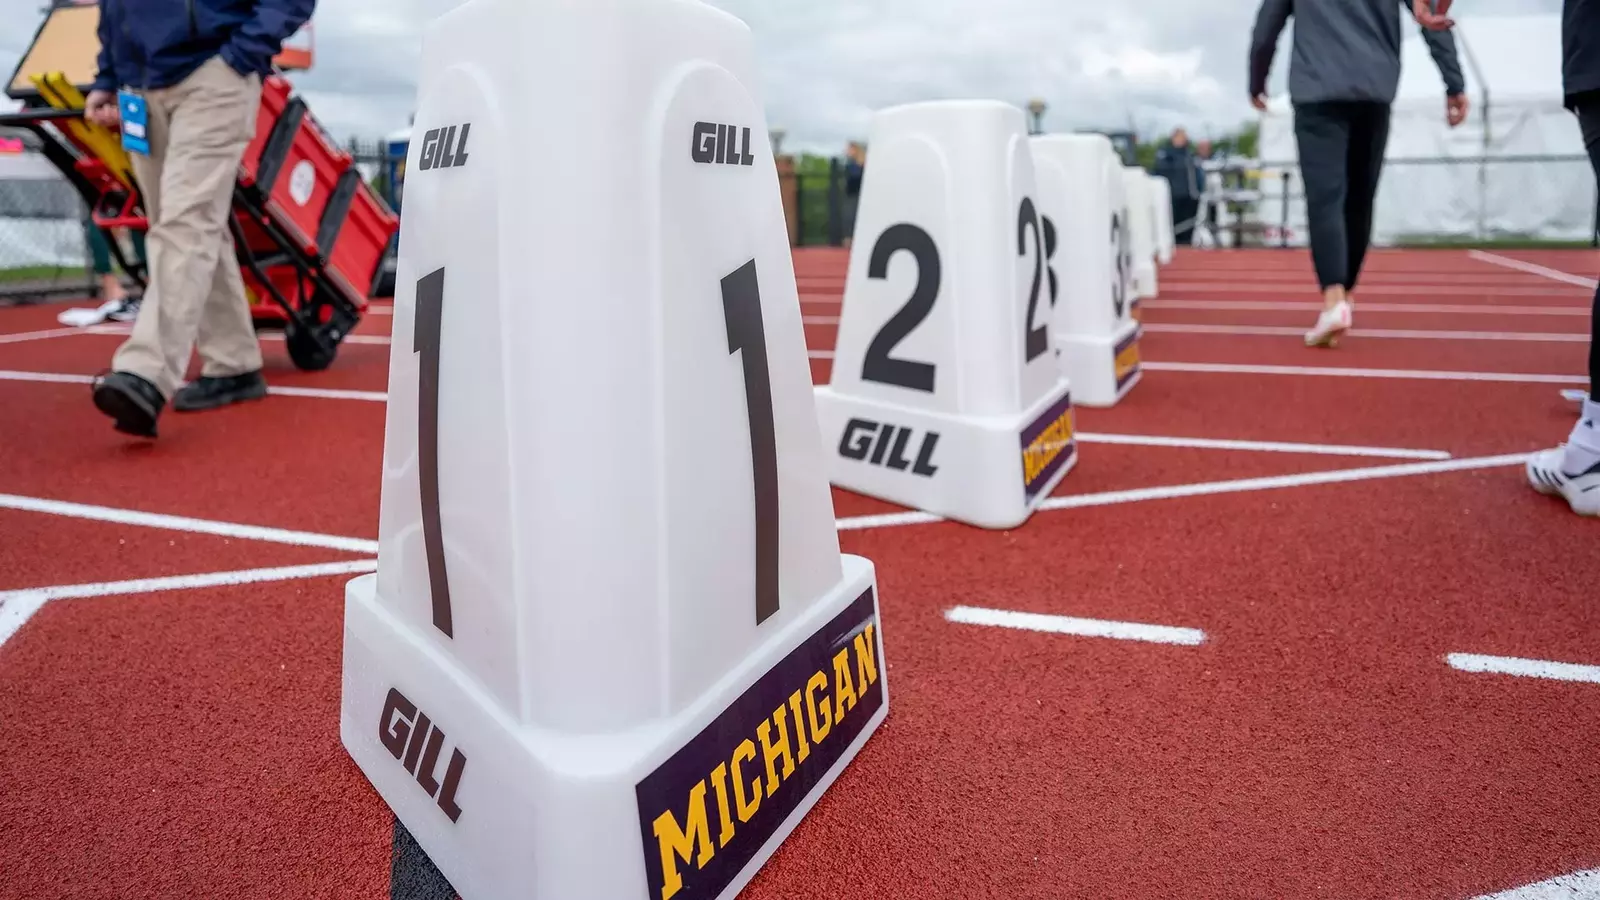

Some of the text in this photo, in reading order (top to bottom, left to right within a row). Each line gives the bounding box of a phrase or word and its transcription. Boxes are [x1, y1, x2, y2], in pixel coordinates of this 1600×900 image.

[419, 122, 471, 171] GILL
[691, 121, 755, 166] GILL
[861, 222, 941, 393] 2
[1018, 196, 1049, 364] 2
[413, 266, 453, 640] 1
[720, 258, 780, 626] 1
[838, 417, 940, 477] GILL
[379, 687, 467, 825] GILL
[652, 622, 878, 900] MICHIGAN
